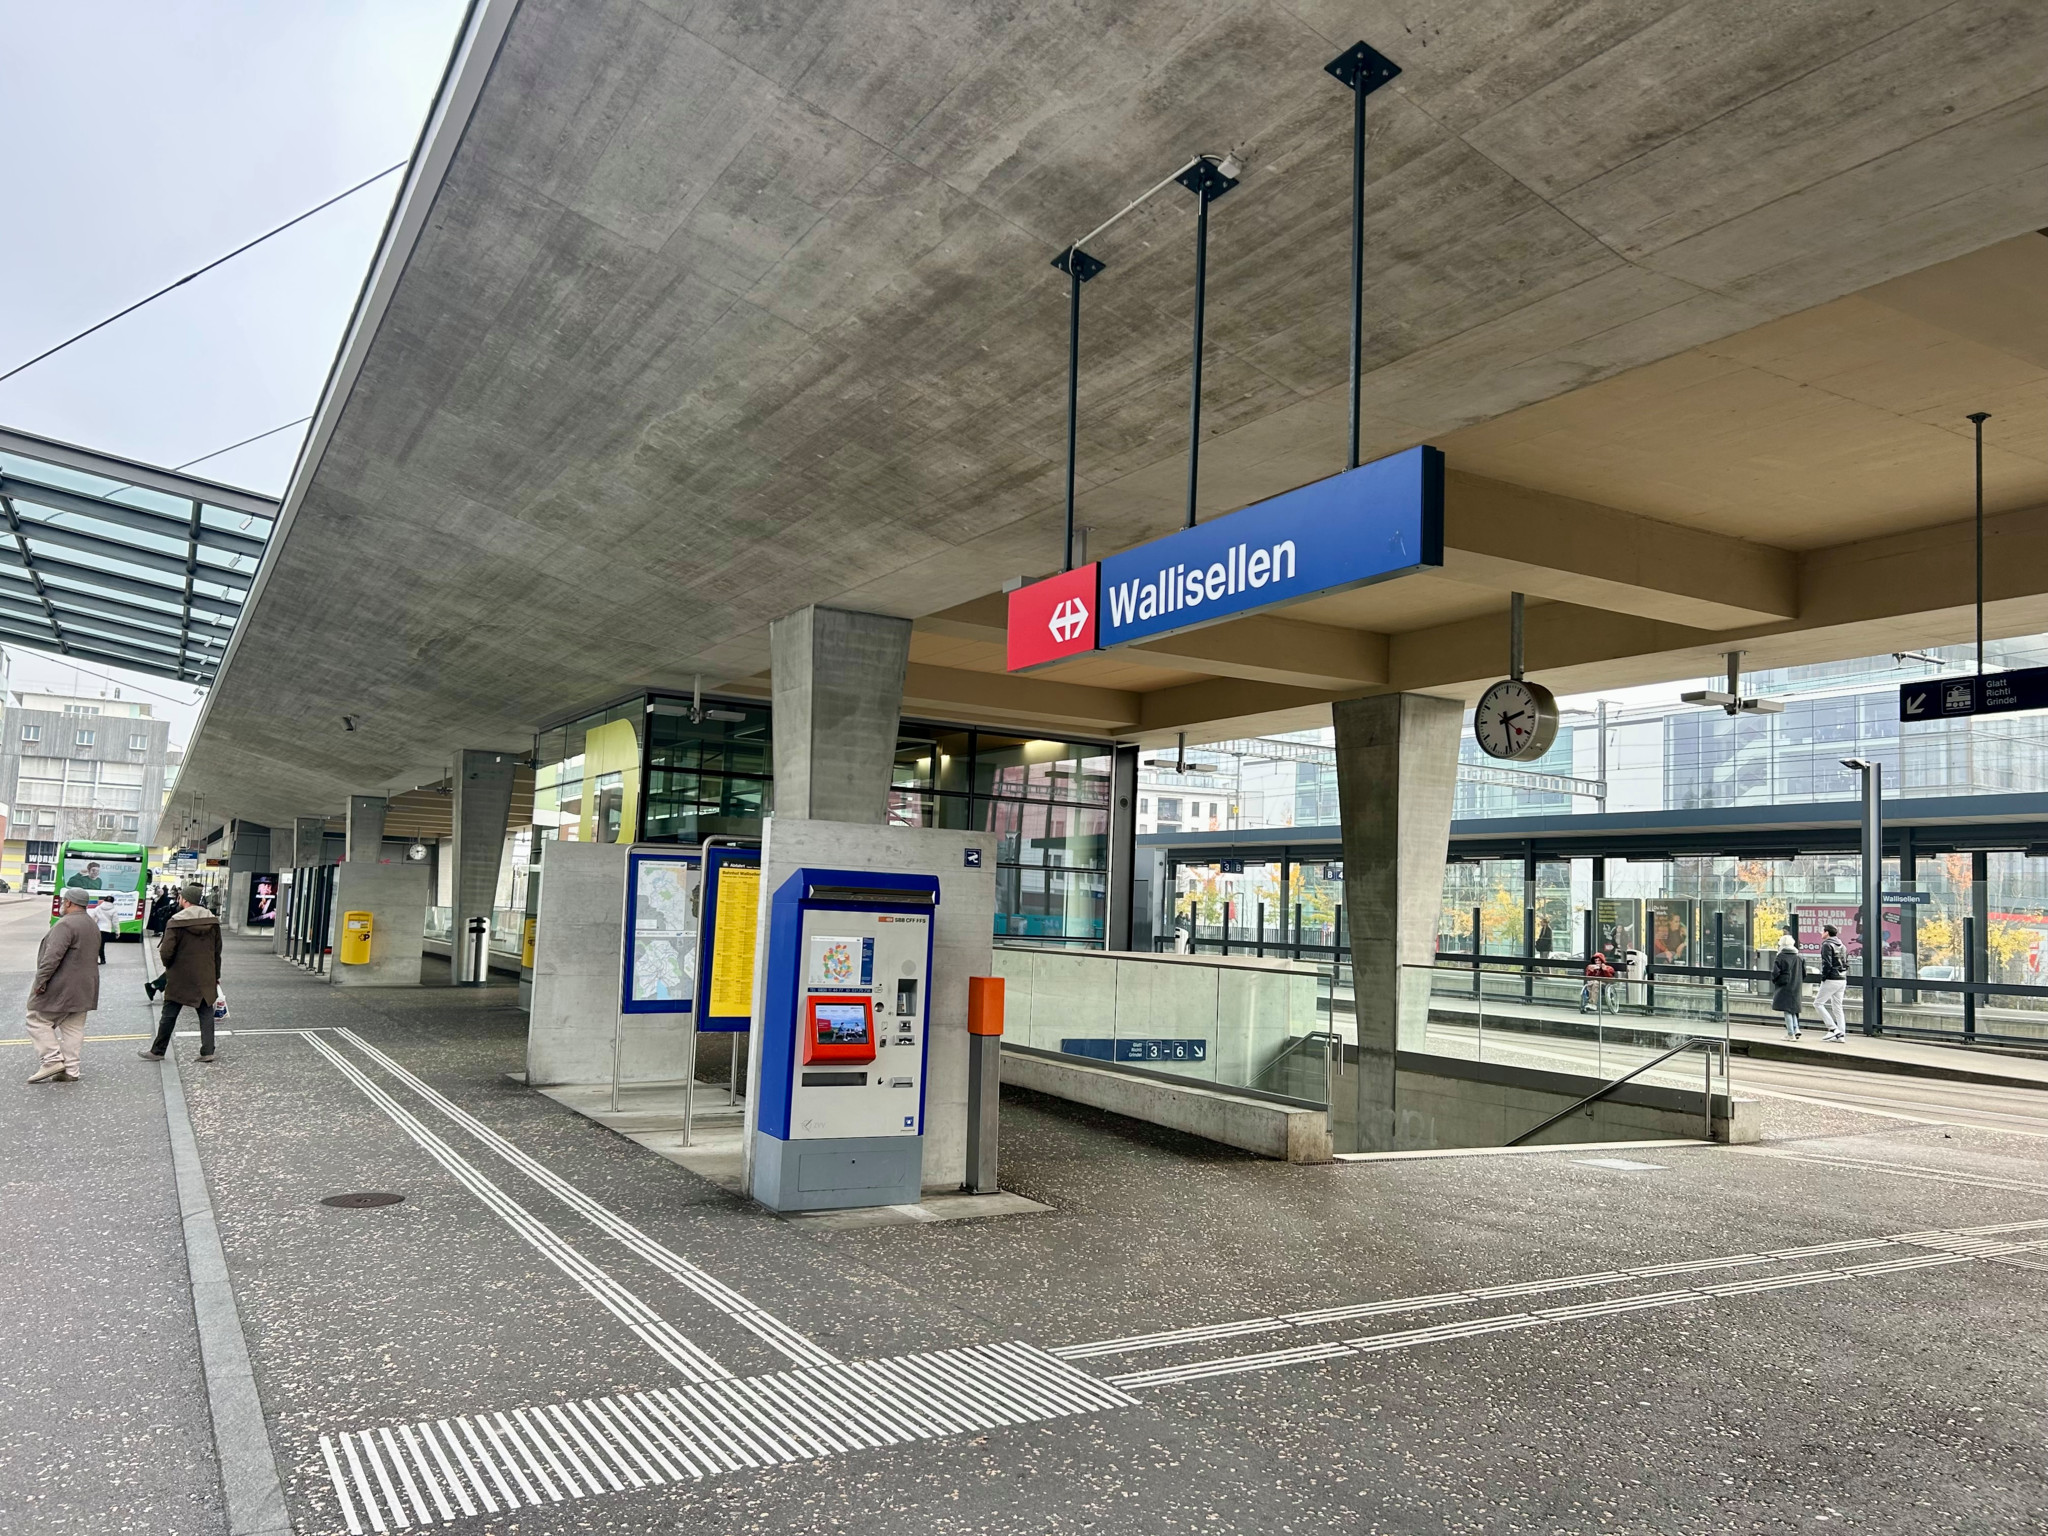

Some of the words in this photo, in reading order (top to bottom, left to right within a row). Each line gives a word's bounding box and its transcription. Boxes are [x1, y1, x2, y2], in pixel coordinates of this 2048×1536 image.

[1108, 539, 1296, 628] Wallisellen
[1986, 679, 2006, 688] Glatt
[1986, 688, 2010, 696] Richti
[1986, 696, 2016, 706] Grindel
[1224, 863, 1230, 872] 3
[1236, 864, 1242, 872] B
[1327, 870, 1333, 878] B
[1882, 895, 1920, 903] Wallisellen
[1818, 916, 1853, 926] STÄNDIG
[1150, 1046, 1158, 1058] 3
[1176, 1046, 1184, 1058] 6
